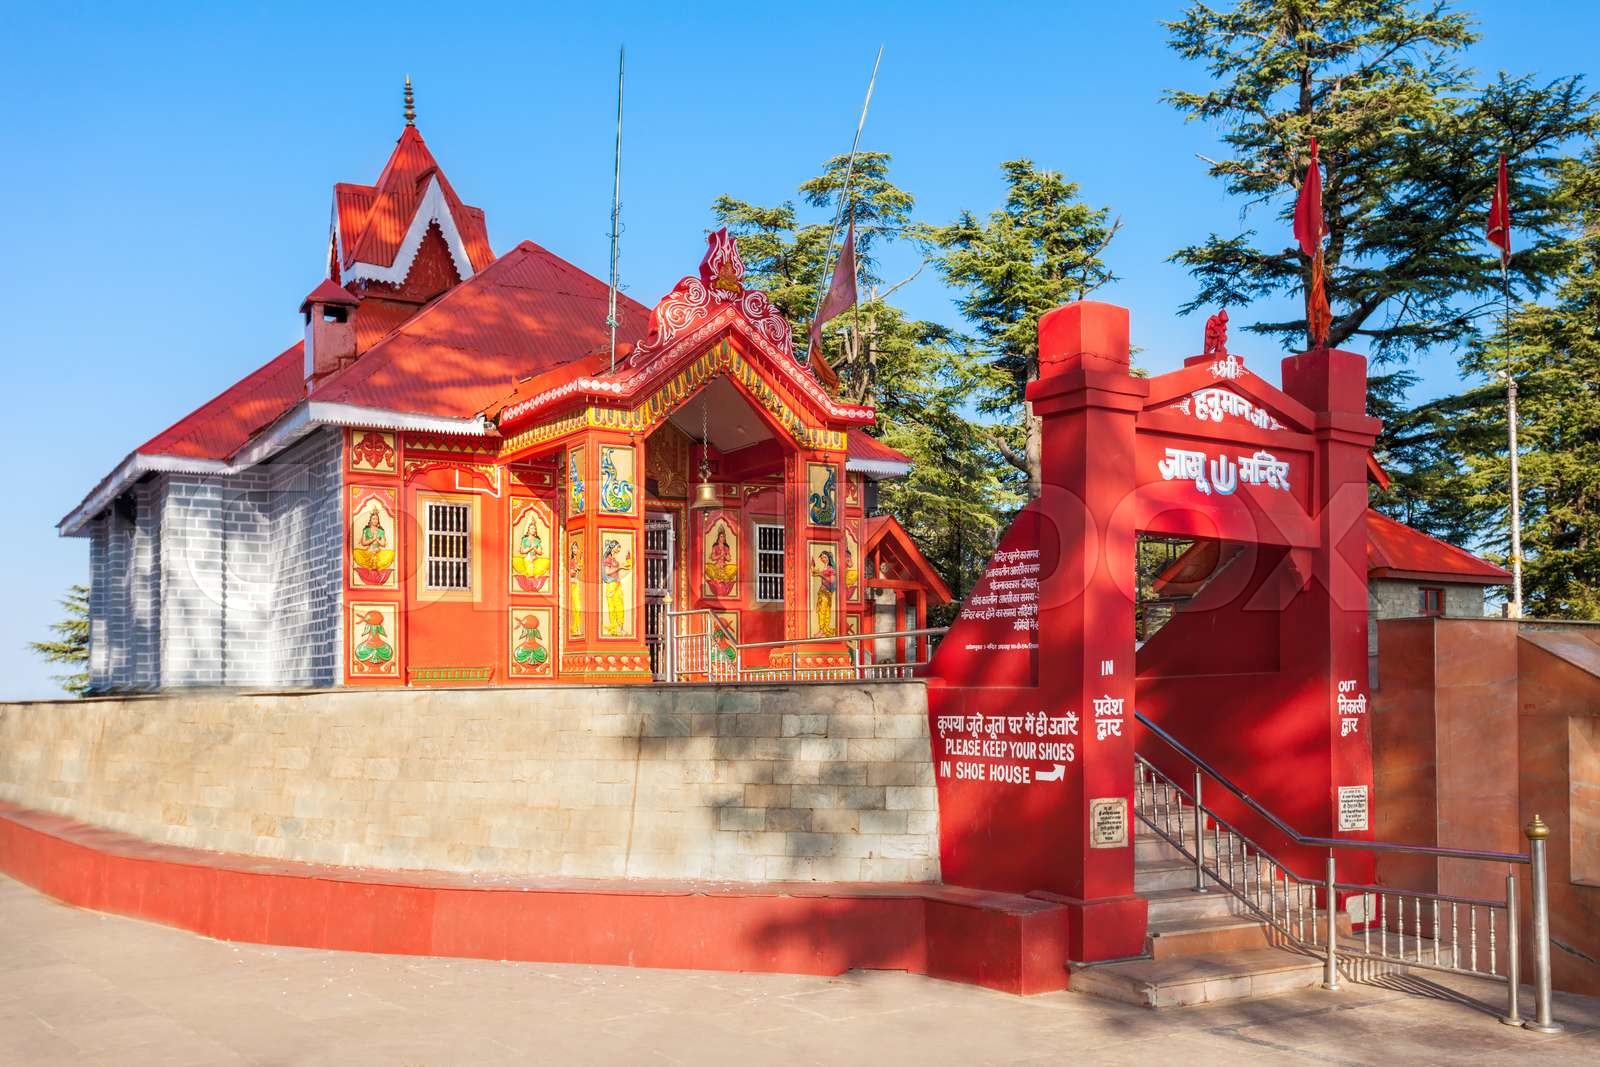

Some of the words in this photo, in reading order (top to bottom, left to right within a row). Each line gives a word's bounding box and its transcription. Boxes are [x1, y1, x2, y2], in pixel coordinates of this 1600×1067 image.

[1218, 355, 1239, 380] श्री
[1191, 388, 1252, 423] हनुमान
[1250, 407, 1270, 430] जी
[1158, 447, 1212, 496] जाखू
[1238, 450, 1291, 492] मन्दिर
[1101, 660, 1114, 676] IN
[1338, 680, 1356, 693] OUT
[1093, 694, 1124, 717] प्रवेश
[1337, 693, 1367, 716] निकासी
[938, 714, 964, 739] कृपया
[966, 712, 983, 739] जूते
[985, 715, 1006, 740] जूता
[1007, 716, 1024, 736] घर
[1025, 711, 1035, 735] में
[1035, 710, 1048, 737] ही
[1095, 718, 1124, 741] द्वार
[1341, 717, 1359, 737] द्वार
[945, 740, 981, 757] PLEASE
[982, 740, 1007, 758] KEEP
[1009, 741, 1037, 760] YOUR
[1038, 742, 1075, 762] SHOES
[940, 761, 951, 778] IN
[956, 761, 985, 780] SHOE
[989, 764, 1031, 784] HOUSE
